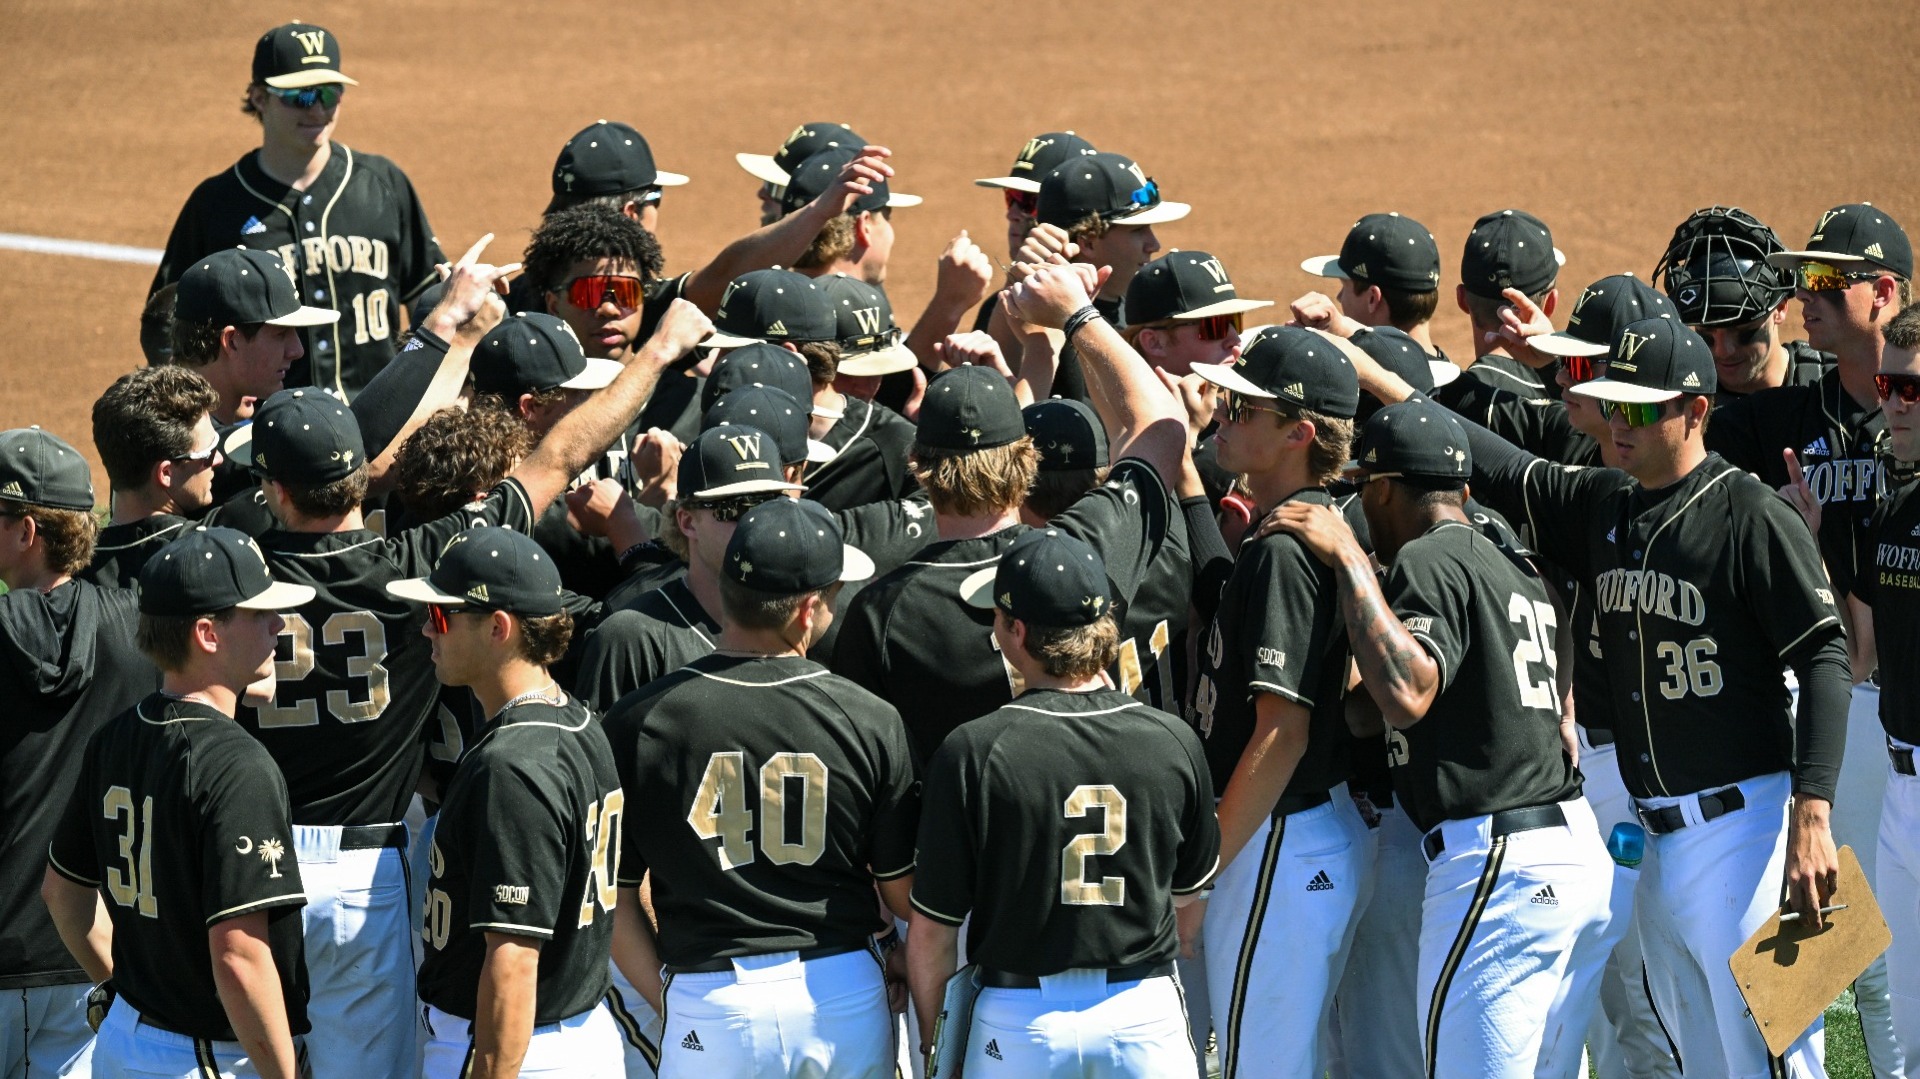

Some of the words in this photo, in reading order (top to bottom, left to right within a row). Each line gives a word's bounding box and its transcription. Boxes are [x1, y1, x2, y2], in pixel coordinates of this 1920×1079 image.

[296, 30, 325, 55] W
[1199, 255, 1229, 284] W
[352, 288, 391, 345] 10
[852, 307, 880, 334] W
[1617, 332, 1649, 361] W
[728, 435, 760, 460] W
[1803, 447, 1830, 456] adidas
[1258, 647, 1286, 670] SOCON
[1508, 592, 1561, 716] 25
[1656, 637, 1724, 700] 36
[257, 610, 391, 729] 23
[687, 751, 829, 871] 40
[103, 785, 158, 919] 31
[577, 787, 625, 930] 20
[1061, 784, 1127, 906] 2
[495, 885, 530, 906] SOCON
[1306, 882, 1335, 891] adidas
[1530, 896, 1559, 905] adidas
[681, 1041, 704, 1051] adidas
